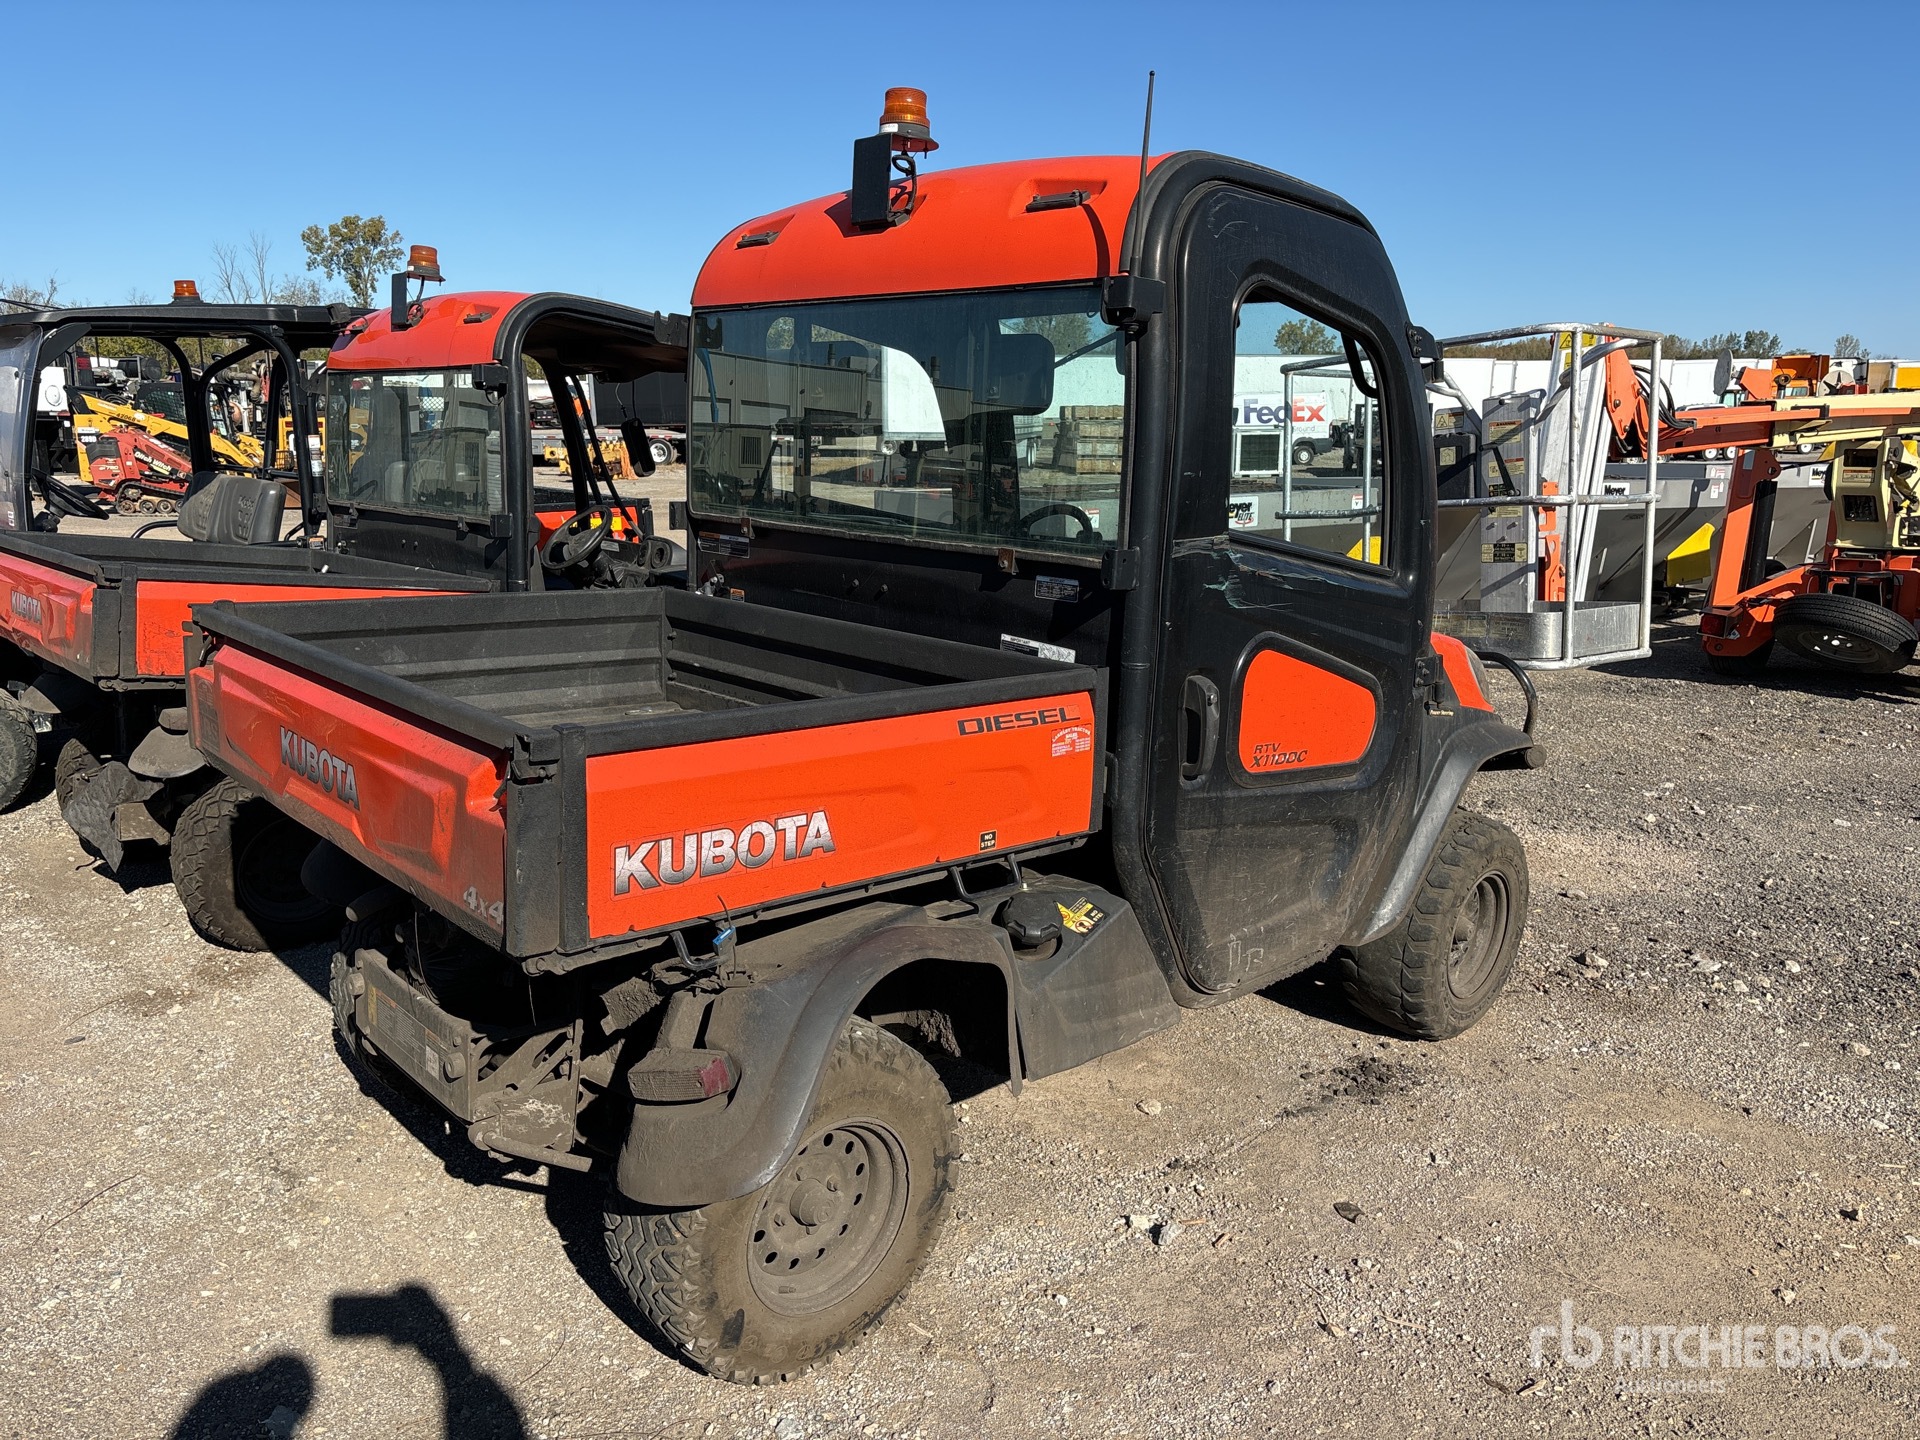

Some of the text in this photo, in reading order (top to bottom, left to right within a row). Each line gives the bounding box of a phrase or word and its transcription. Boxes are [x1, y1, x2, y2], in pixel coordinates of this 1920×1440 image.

[134, 451, 172, 471] Ditch Witch
[1229, 502, 1253, 518] eyer
[11, 590, 43, 626] KUBOTA
[957, 707, 1081, 736] DIESEL
[1249, 750, 1308, 768] X1100C
[1253, 743, 1281, 754] RTV
[280, 725, 360, 811] KUBOTA
[613, 810, 836, 896] KUBOTA
[980, 840, 995, 848] STEP
[463, 886, 504, 925] 4x4
